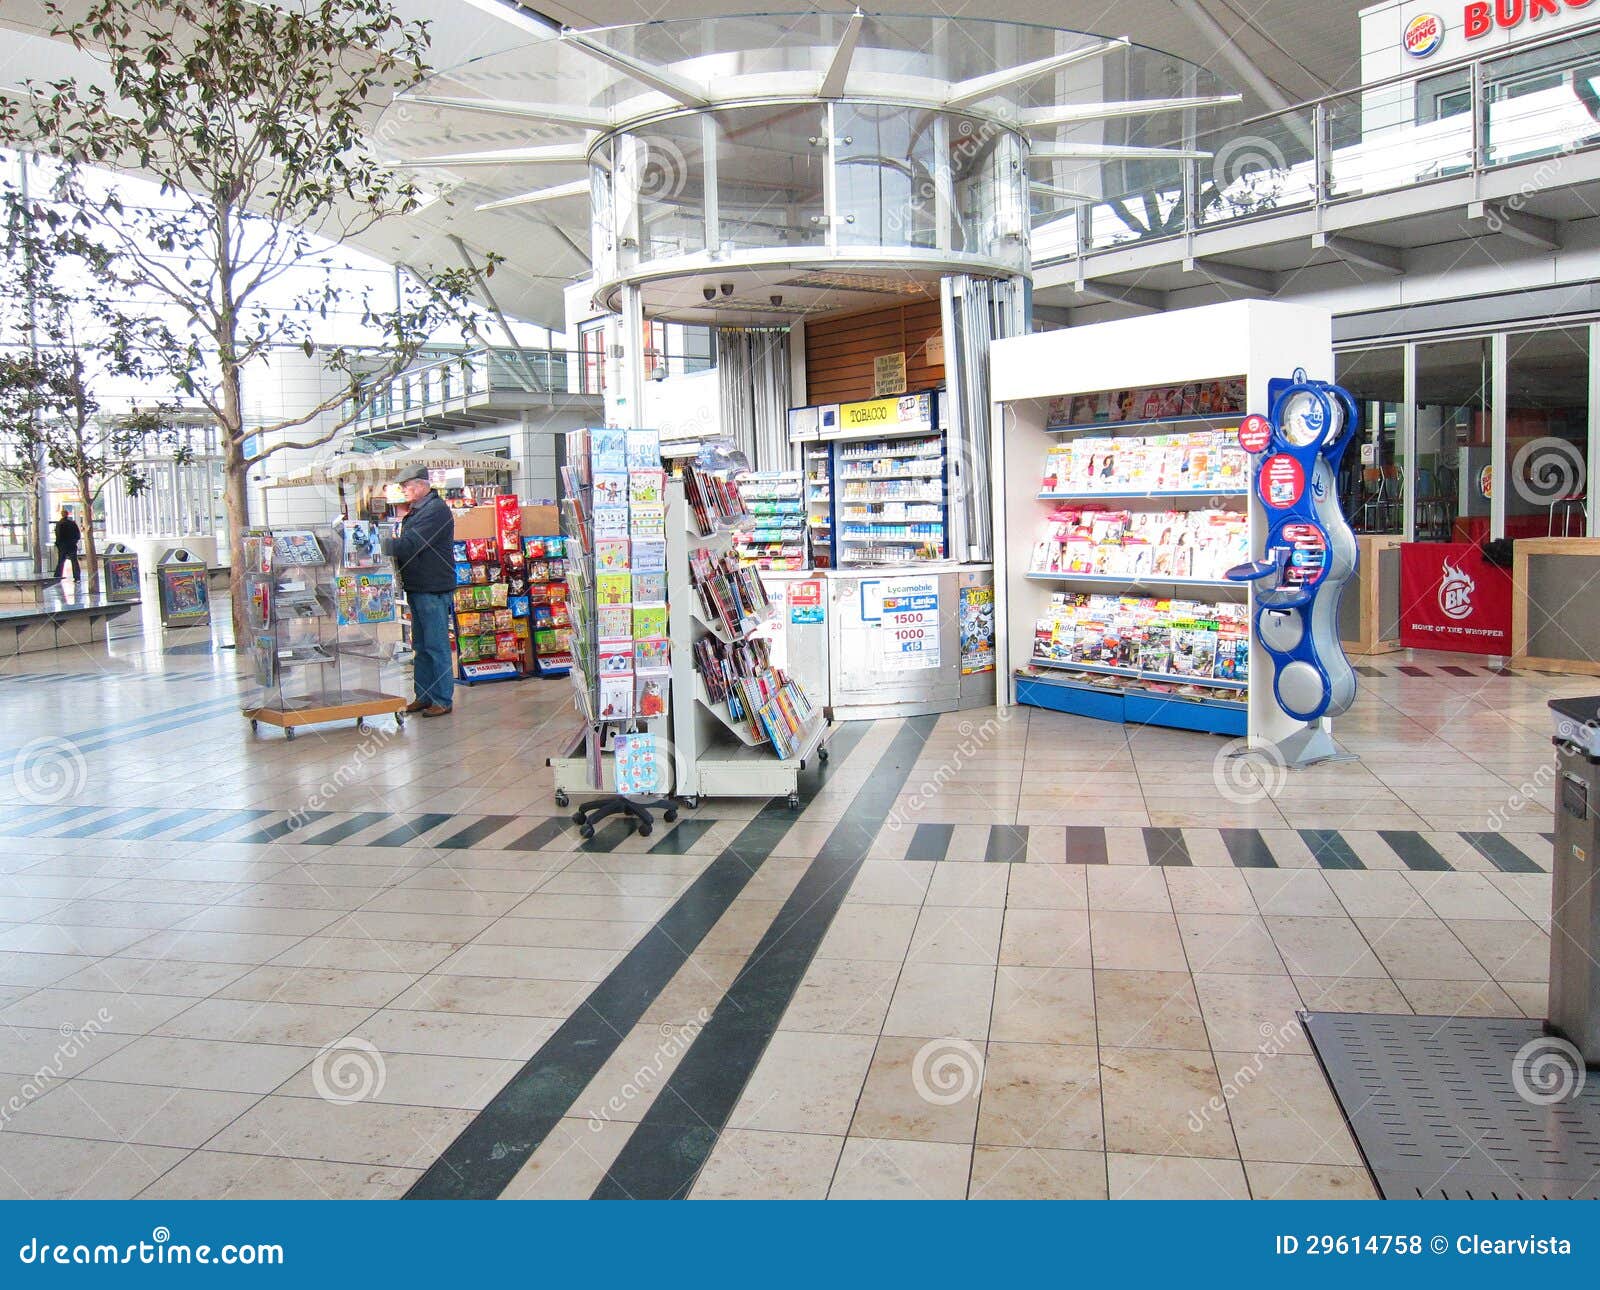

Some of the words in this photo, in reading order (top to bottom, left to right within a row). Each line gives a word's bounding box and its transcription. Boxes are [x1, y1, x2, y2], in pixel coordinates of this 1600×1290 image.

[1464, 0, 1593, 40] BUR
[1406, 17, 1436, 42] BURGER
[1407, 26, 1437, 49] KING
[850, 406, 887, 423] TOBACCO
[887, 583, 933, 595] Lycamobile
[897, 598, 909, 607] Sri
[911, 596, 936, 607] Lanka
[1446, 588, 1472, 609] BK
[893, 613, 924, 625] 1500
[895, 628, 924, 640] 1000
[1412, 623, 1433, 631] HOME
[1435, 624, 1446, 632] OF
[1447, 625, 1462, 633] THE
[1465, 627, 1504, 637] WHOPPER
[476, 662, 502, 671] HARIBO
